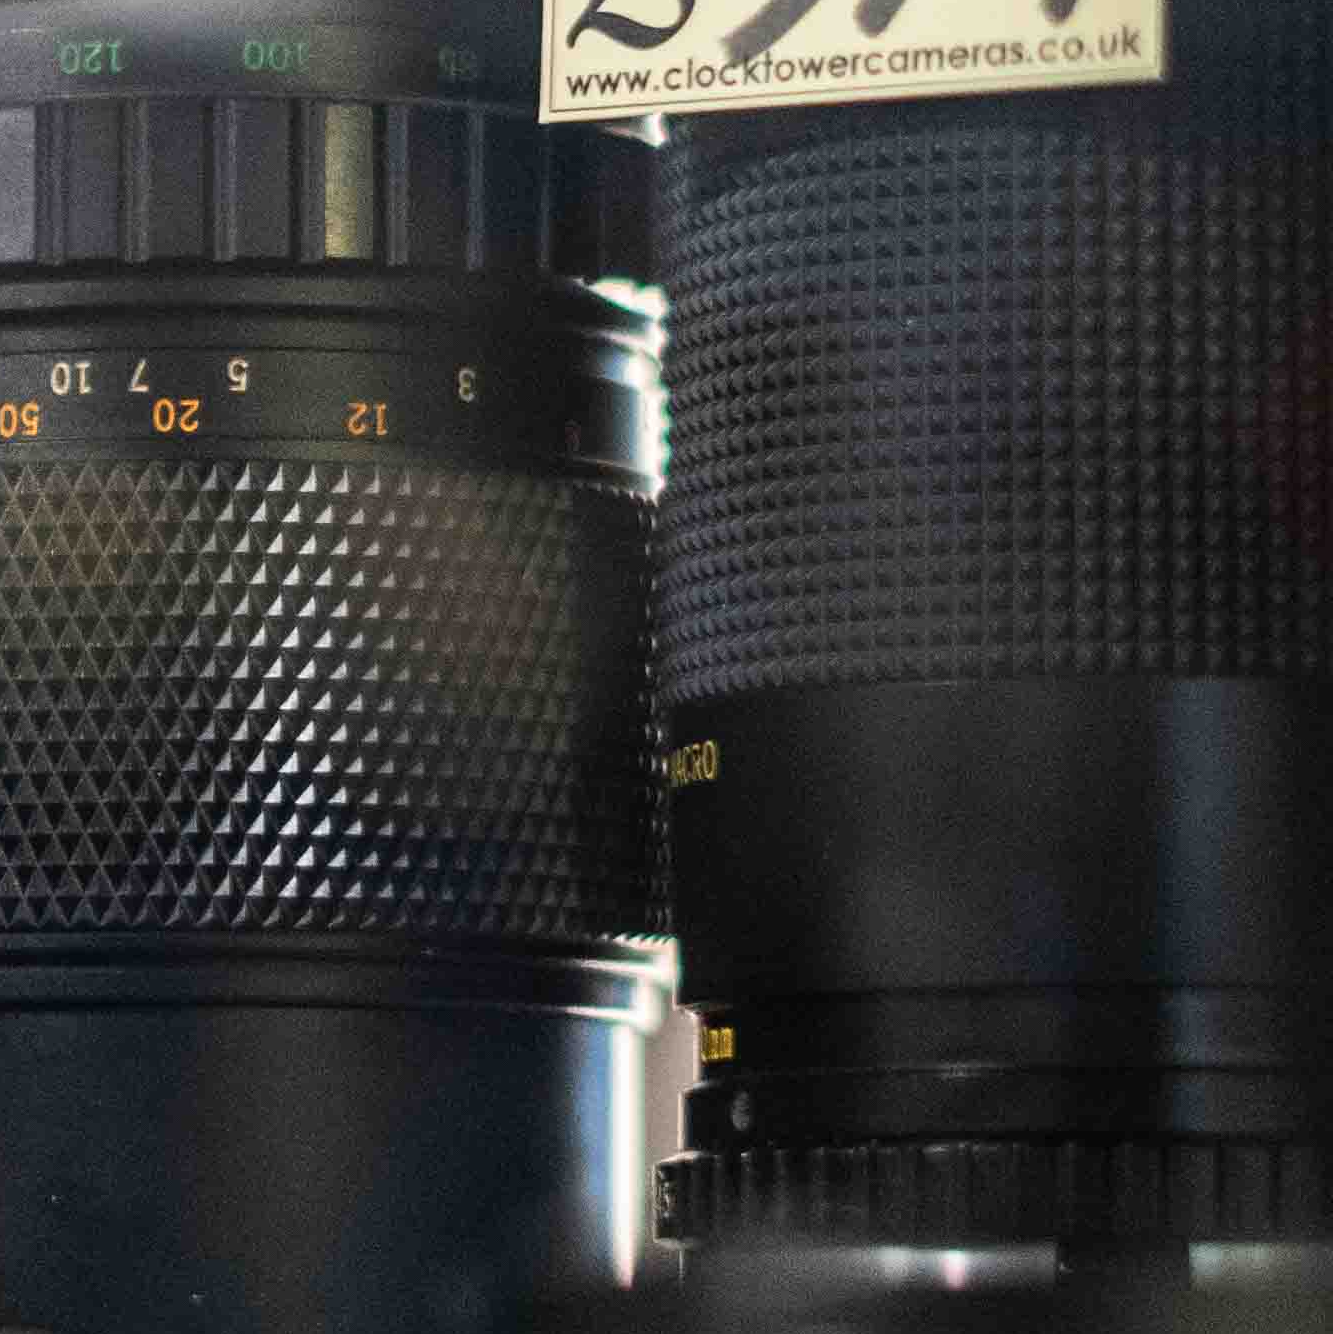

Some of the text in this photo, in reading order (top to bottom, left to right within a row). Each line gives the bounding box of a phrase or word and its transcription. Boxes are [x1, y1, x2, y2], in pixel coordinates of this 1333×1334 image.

[55, 38, 124, 76] 120
[242, 40, 309, 76] 100
[566, 24, 1142, 98] www.clocktowercameras.co.uk
[50, 362, 94, 396] 10
[127, 359, 150, 393] 7
[226, 358, 250, 393] 5
[458, 367, 476, 404] 3
[152, 398, 201, 433] 20
[346, 401, 389, 437] 12
